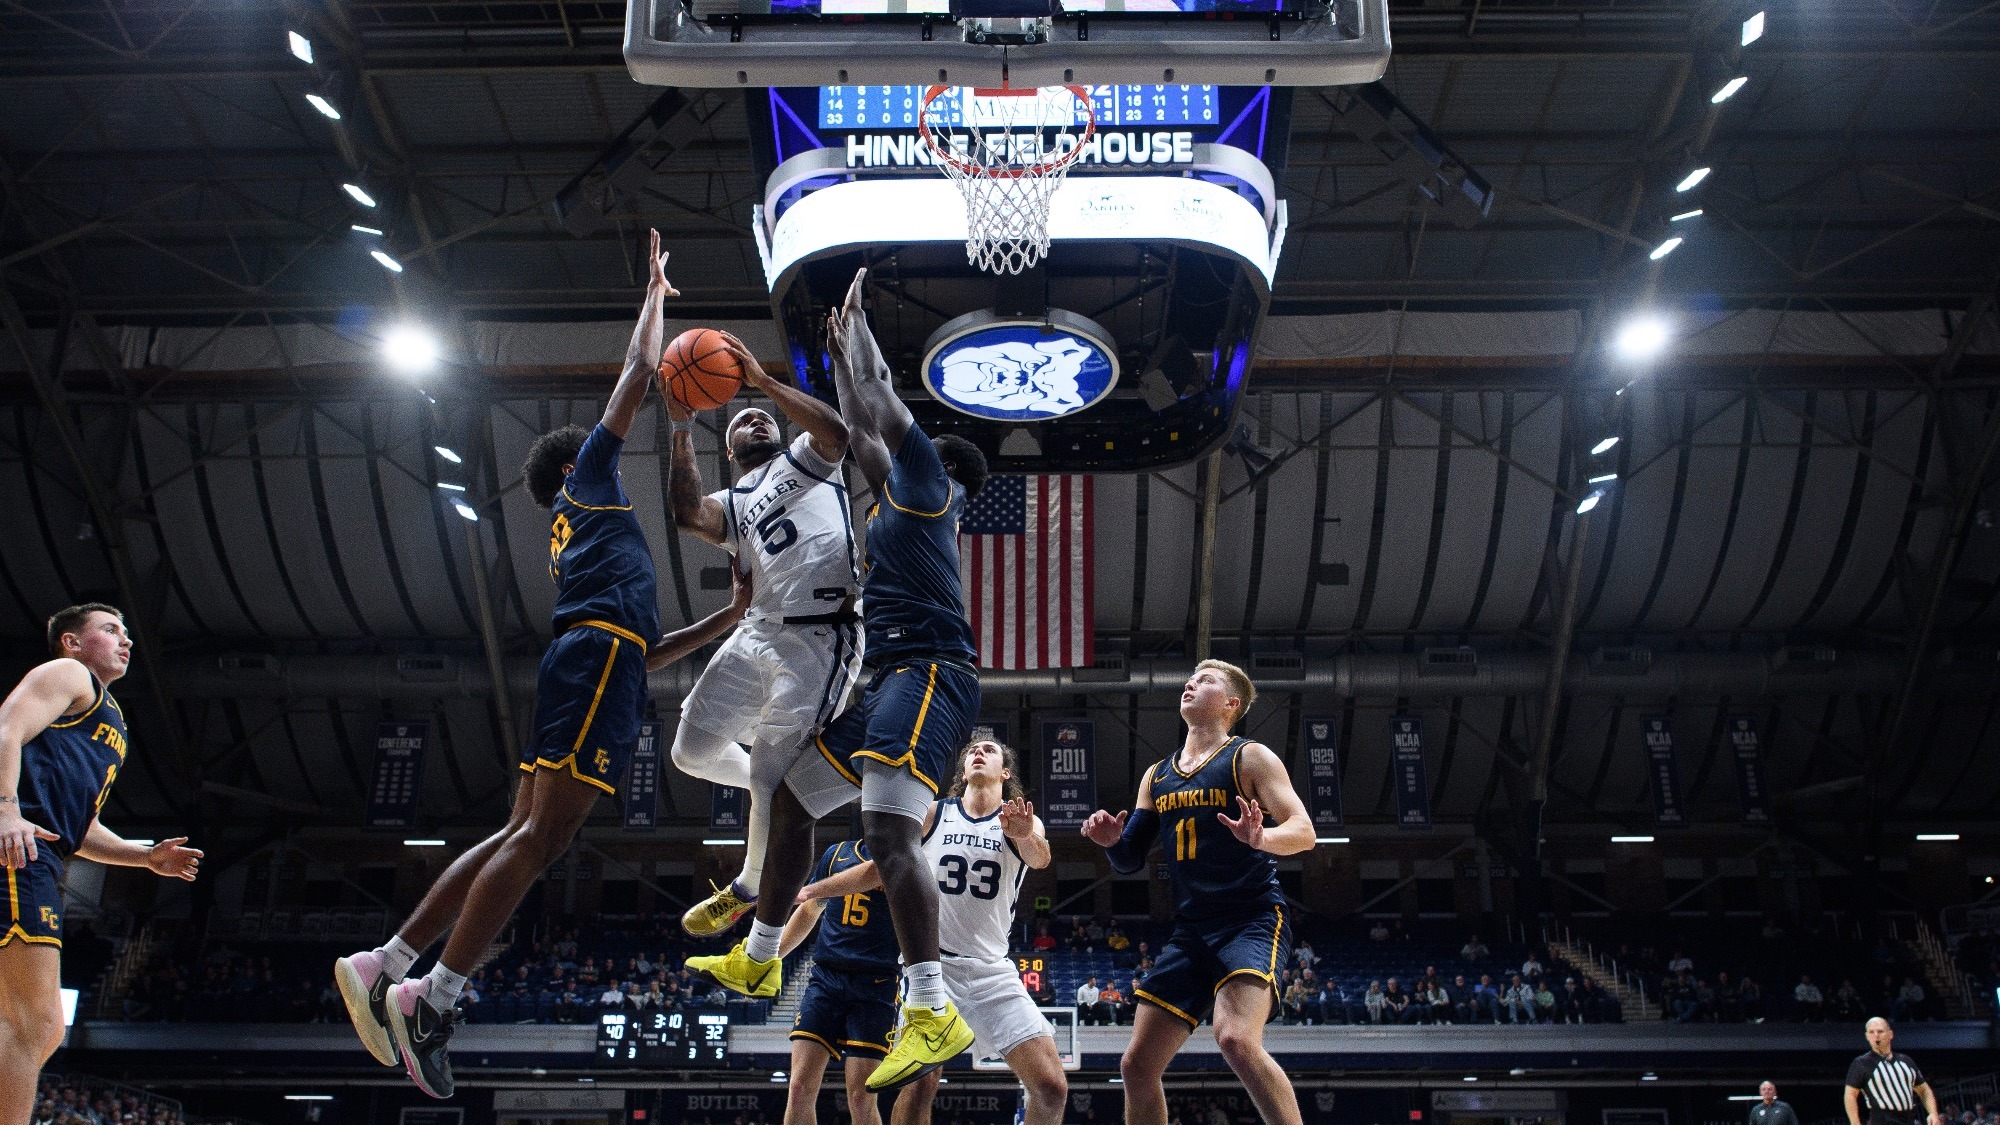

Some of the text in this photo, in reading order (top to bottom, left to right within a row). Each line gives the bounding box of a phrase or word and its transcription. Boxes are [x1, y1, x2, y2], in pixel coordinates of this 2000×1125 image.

[882, 85, 891, 95] 3
[904, 85, 911, 95] 1
[827, 98, 913, 110] 14 2 1 0
[950, 100, 959, 110] 4
[1126, 94, 1210, 107] 15 11 1 1
[826, 112, 913, 124] 33 0 0 0
[951, 112, 960, 123] 3
[1125, 108, 1212, 121] 23 2 1 0
[847, 131, 1193, 167] HINKLE FIELDHOUSE
[739, 478, 803, 539] BUTLER
[756, 505, 798, 556] 5
[638, 736, 655, 752] NIT
[1394, 733, 1420, 747] NCAA
[1052, 748, 1086, 773] 2011
[1310, 748, 1335, 764] 1929
[1317, 786, 1332, 796] 17-2
[1155, 788, 1227, 814] FRANKLIN
[942, 834, 1002, 853] BUTLER
[1175, 817, 1197, 861] 11
[938, 854, 1002, 900] 33
[841, 893, 872, 927] 15
[39, 906, 60, 931] FC
[1019, 958, 1043, 972] 3:10
[1023, 972, 1040, 992] 19
[655, 1014, 682, 1029] 3:10
[606, 1025, 624, 1040] 40
[661, 1033, 667, 1043] 1
[706, 1025, 723, 1040] 32
[607, 1048, 615, 1058] 4
[628, 1047, 637, 1059] 3
[689, 1048, 697, 1059] 3
[687, 1094, 760, 1111] BUTLER
